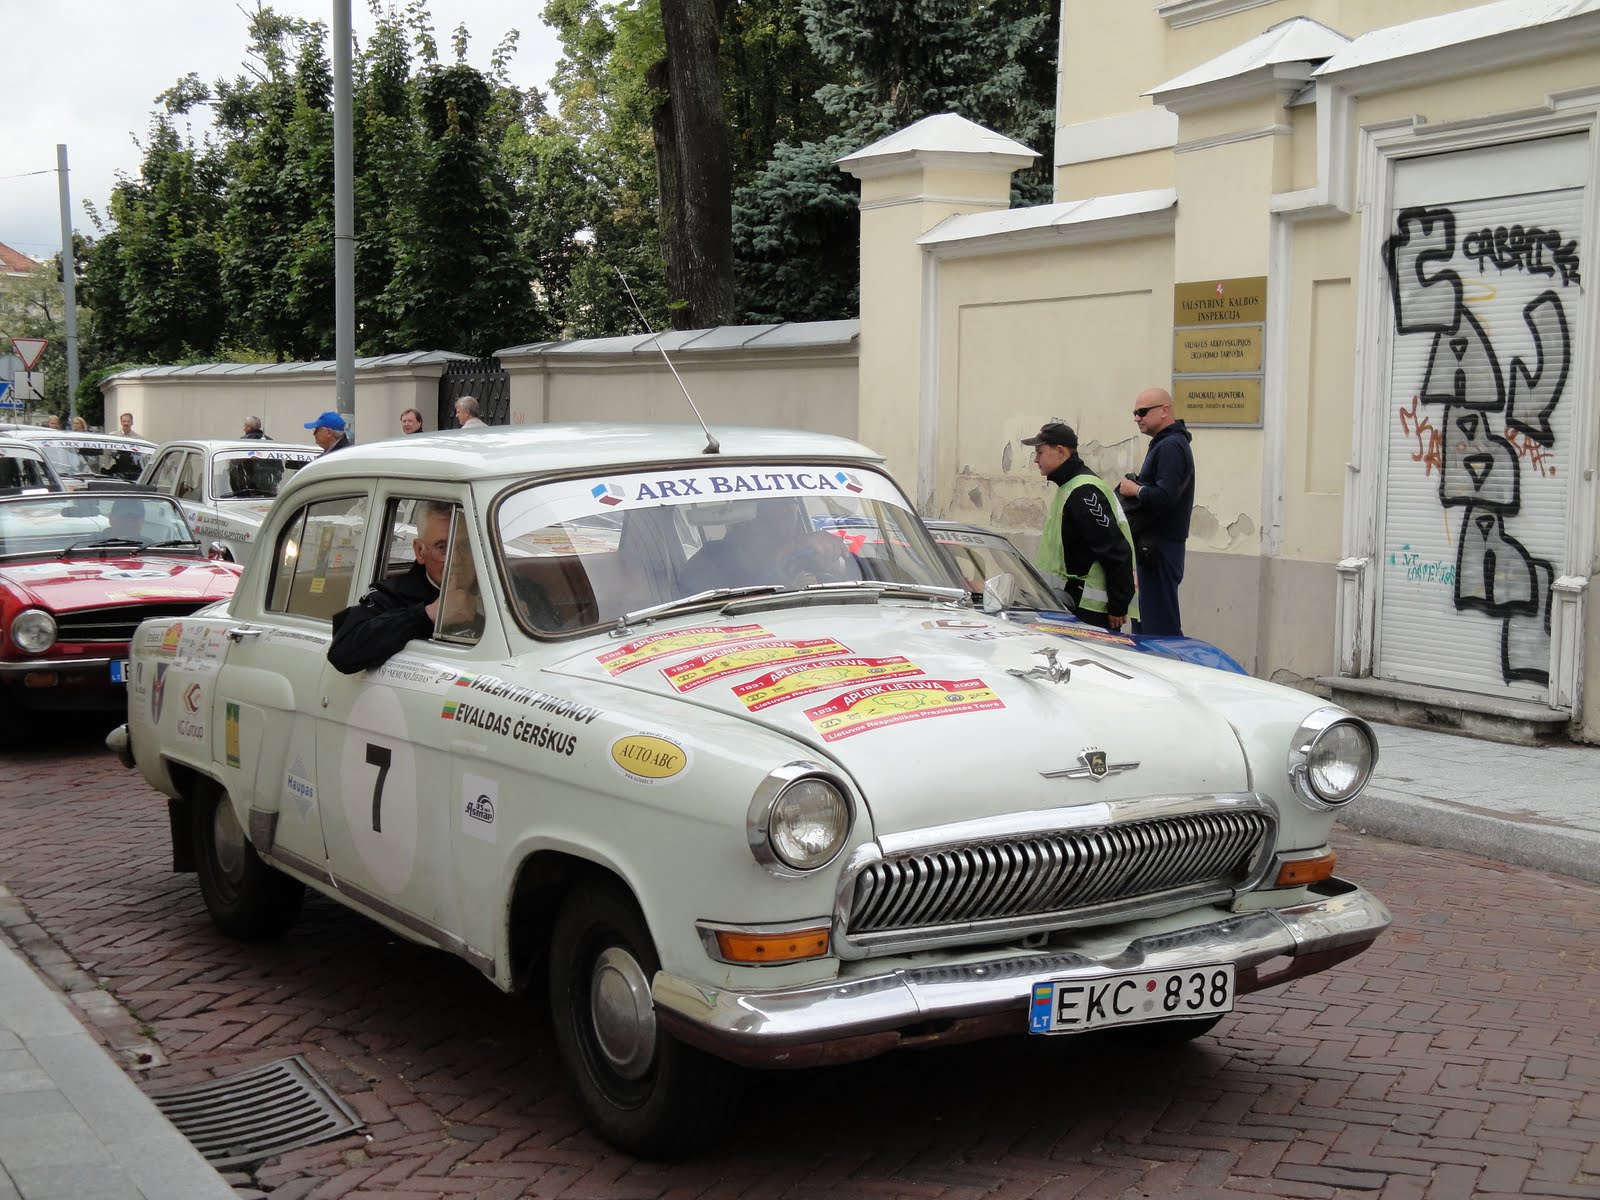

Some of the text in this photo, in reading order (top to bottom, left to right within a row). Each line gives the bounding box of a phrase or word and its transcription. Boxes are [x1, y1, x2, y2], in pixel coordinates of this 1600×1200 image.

[1182, 297, 1259, 310] VALSTYBINĖ KALBOS
[1198, 311, 1240, 321] INSPEKCIJA
[83, 442, 127, 450] BALTICA
[267, 452, 292, 460] ARX
[636, 472, 838, 501] ARX BALTICA
[632, 630, 671, 650] APLINK
[673, 627, 725, 639] LIETUVA
[672, 663, 695, 673] 1931
[702, 646, 740, 664] APLINK
[742, 641, 796, 652] LIETUVA
[684, 674, 720, 689] Lietuvos
[739, 681, 764, 692] 1931
[770, 664, 809, 682] APLINK
[813, 659, 868, 669] LIETUVA
[470, 674, 604, 725] VALENTIN PIMONOV
[754, 695, 791, 710] Lietuvos
[792, 684, 844, 698] Respublikos
[812, 681, 980, 716] 1931 APLINK LIETUVA 2009
[455, 703, 577, 756] EVALDAS ČERŠKUS
[828, 725, 866, 740] Lietuvos
[867, 712, 920, 728] Respublikos
[619, 744, 678, 770] AUTO ABC
[287, 775, 314, 799] Haupas
[365, 742, 392, 833] 7
[1056, 970, 1229, 1026] EKC 838
[1032, 1015, 1050, 1028] LT
